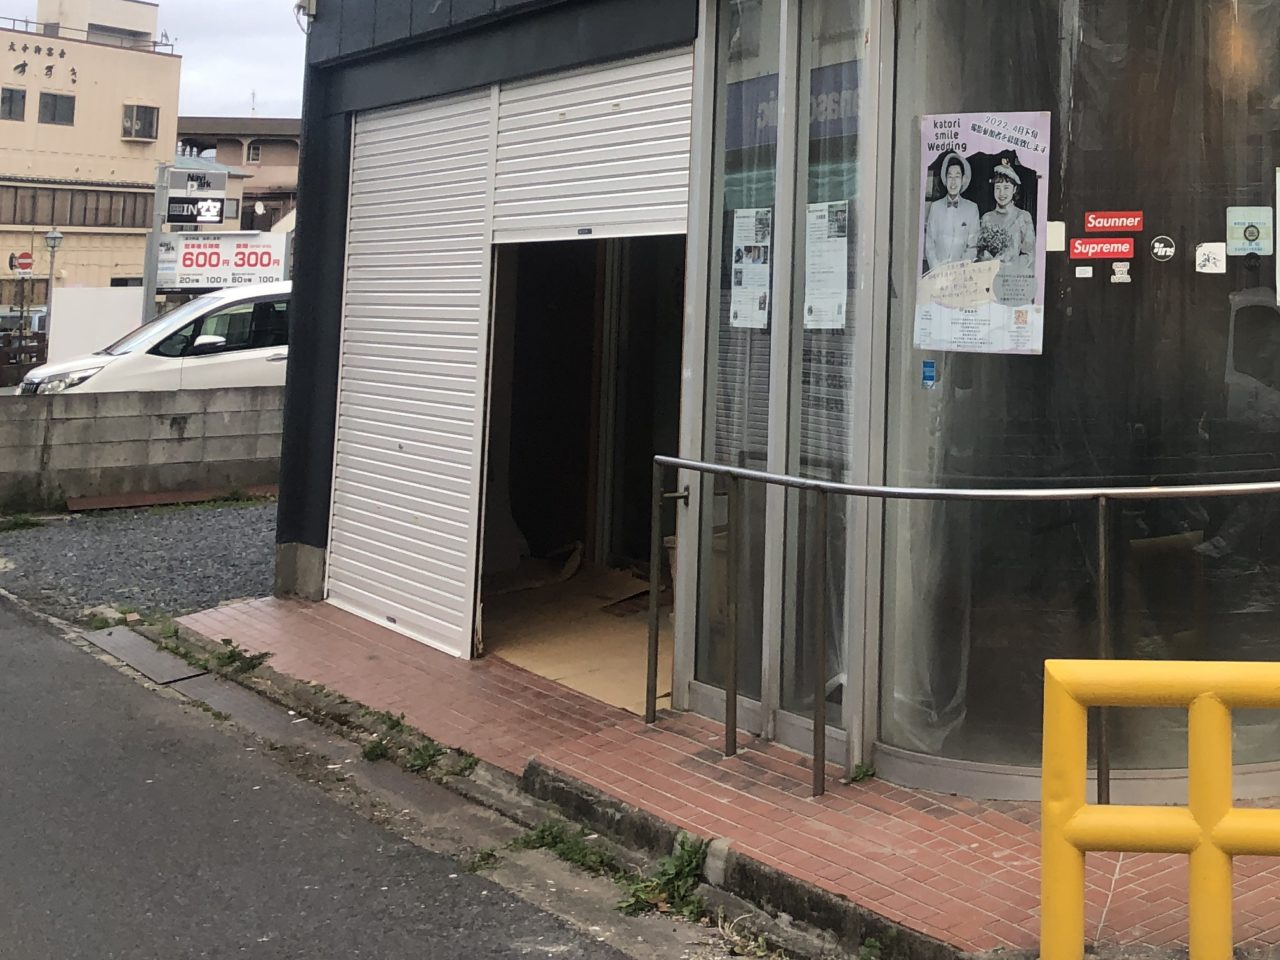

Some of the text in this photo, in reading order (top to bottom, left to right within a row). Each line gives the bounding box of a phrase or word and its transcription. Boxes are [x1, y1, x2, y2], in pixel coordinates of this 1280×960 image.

[933, 118, 961, 129] katori
[935, 130, 959, 140] smile
[927, 141, 967, 152] Wedding
[183, 204, 198, 215] IN
[1087, 214, 1141, 228] Saunner
[1074, 240, 1130, 256] Supreme
